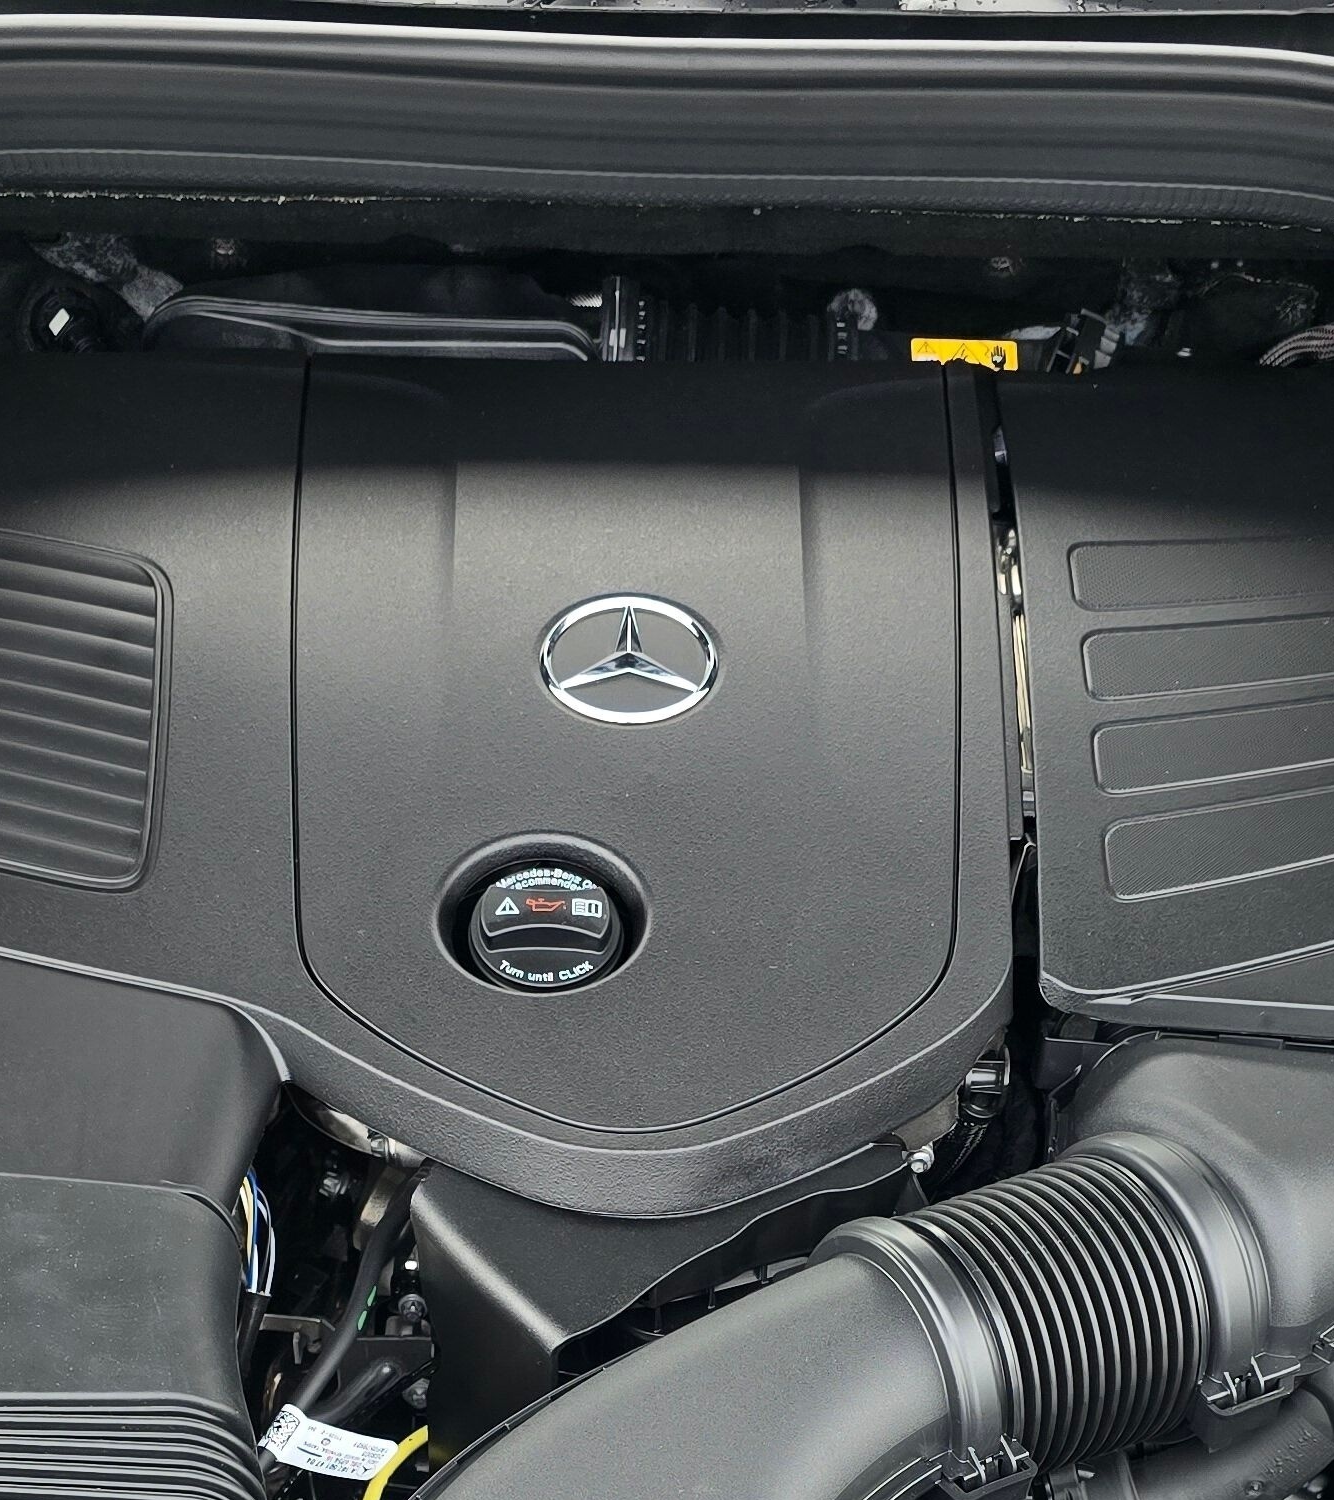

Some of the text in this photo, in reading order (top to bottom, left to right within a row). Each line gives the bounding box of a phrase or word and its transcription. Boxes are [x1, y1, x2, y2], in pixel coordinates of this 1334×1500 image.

[499, 959, 594, 982] Turn until CLICK
